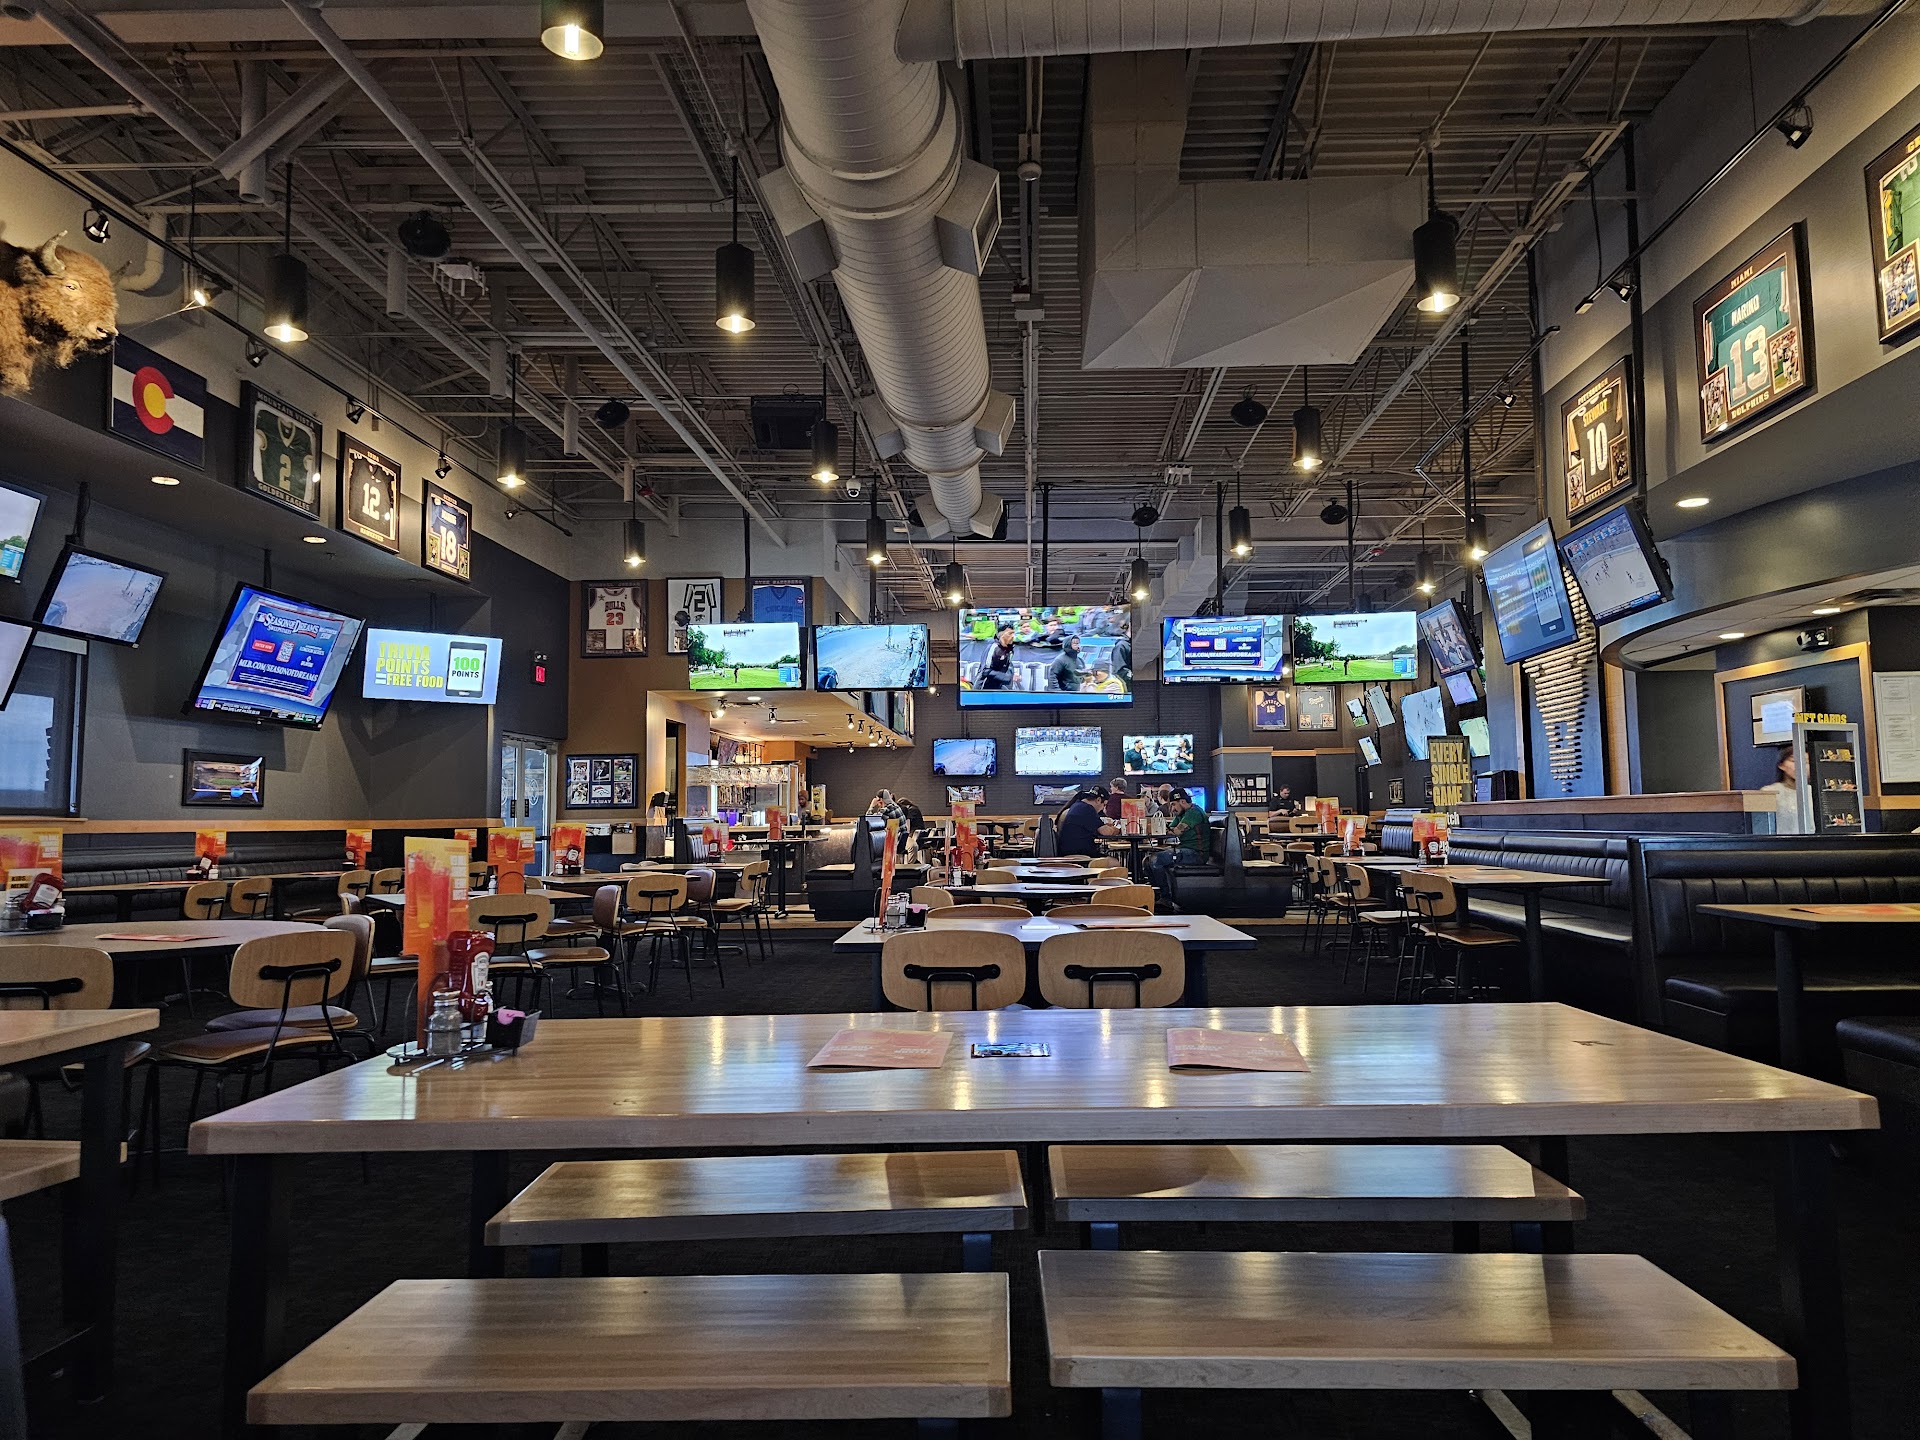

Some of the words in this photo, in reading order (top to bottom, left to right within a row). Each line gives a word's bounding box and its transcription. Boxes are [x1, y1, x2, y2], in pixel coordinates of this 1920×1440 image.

[1730, 266, 1754, 289] MIAMI
[1730, 324, 1770, 402] 13
[257, 391, 294, 416] MOUNTAIN
[295, 412, 315, 429] VISTA
[1582, 397, 1608, 428] STEWART
[1731, 391, 1770, 419] DOLPHINS
[1586, 422, 1608, 476] 10
[279, 453, 292, 492] 2
[257, 483, 285, 501] GOLDEN
[285, 494, 310, 511] EAGLES
[362, 483, 380, 520] 12
[1585, 483, 1612, 504] STEELERS
[440, 525, 457, 564] 18
[604, 601, 626, 612] BULLS
[694, 590, 706, 613] 2
[606, 612, 624, 626] 23
[379, 642, 431, 660] TRIVIA
[376, 658, 431, 675] POINTS
[453, 656, 480, 671] 100
[415, 675, 444, 688] FOOD
[451, 670, 480, 679] POINTS
[1266, 705, 1276, 713] 15
[1794, 712, 1816, 724] GIFT
[1817, 713, 1847, 724] CARDS
[1430, 742, 1467, 763] EVERY.
[1431, 764, 1473, 784] SINGLE.
